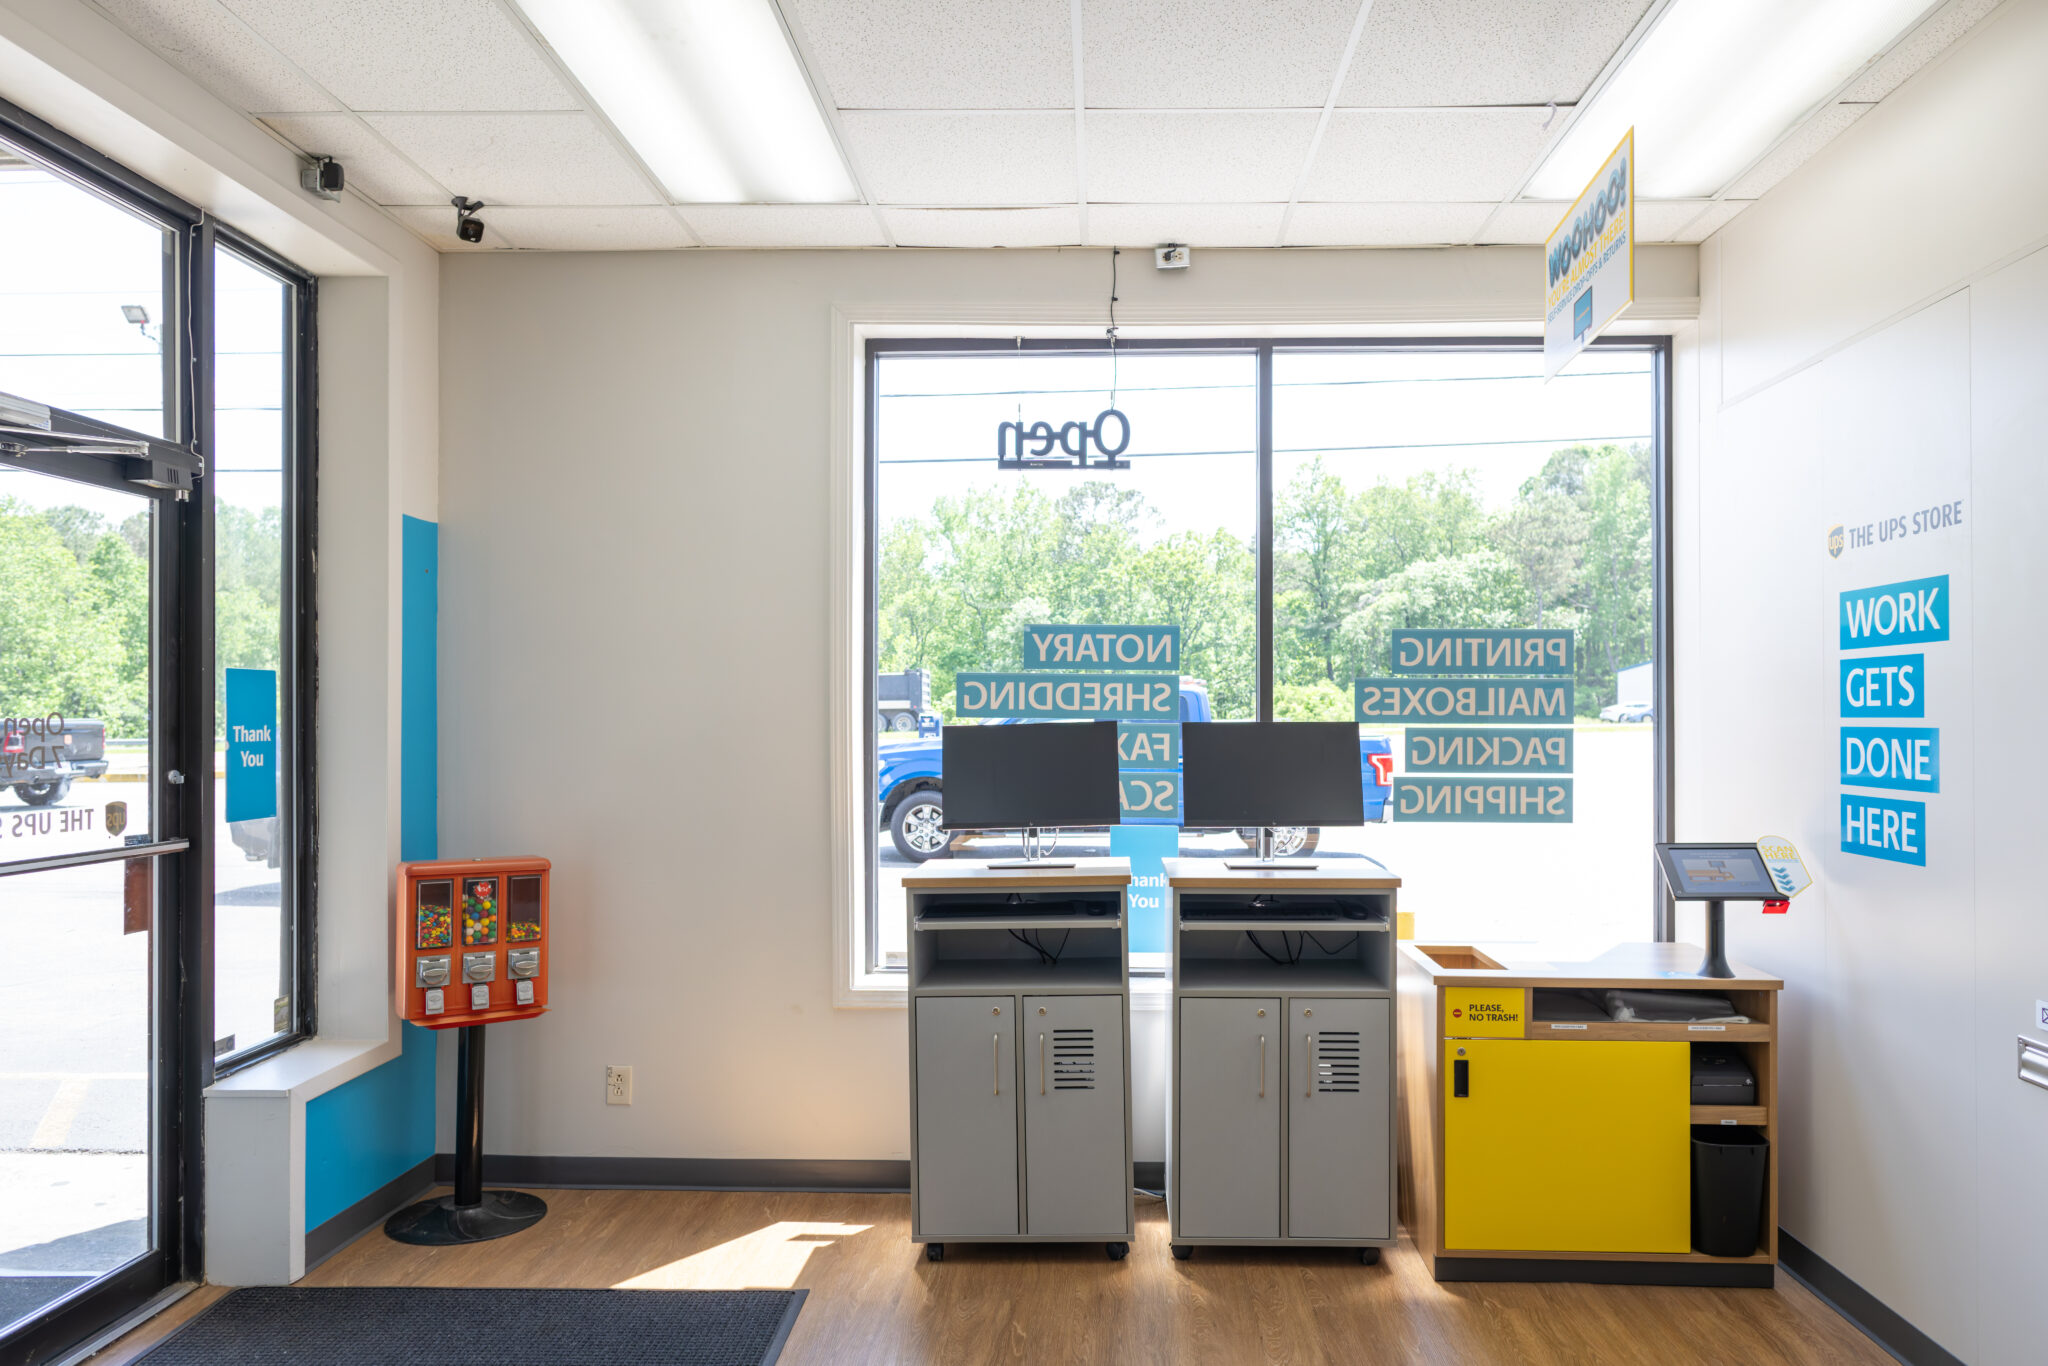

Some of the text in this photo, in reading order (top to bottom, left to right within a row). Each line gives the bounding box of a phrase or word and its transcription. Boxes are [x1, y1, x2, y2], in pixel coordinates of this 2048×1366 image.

[1549, 156, 1627, 288] WOOHOO!
[1571, 241, 1598, 287] ALMOST
[1599, 209, 1627, 253] THERE!
[1849, 524, 1874, 549] THE
[1879, 515, 1907, 542] UPS
[1912, 500, 1963, 535] STORE
[1846, 587, 1941, 639] WORK
[1846, 664, 1915, 708] GETS
[232, 725, 271, 743] Thank
[240, 751, 264, 767] You
[1846, 737, 1931, 781] DONE
[1847, 804, 1918, 854] HERE
[1128, 894, 1159, 908] You
[1469, 1004, 1504, 1013] PLEASE,
